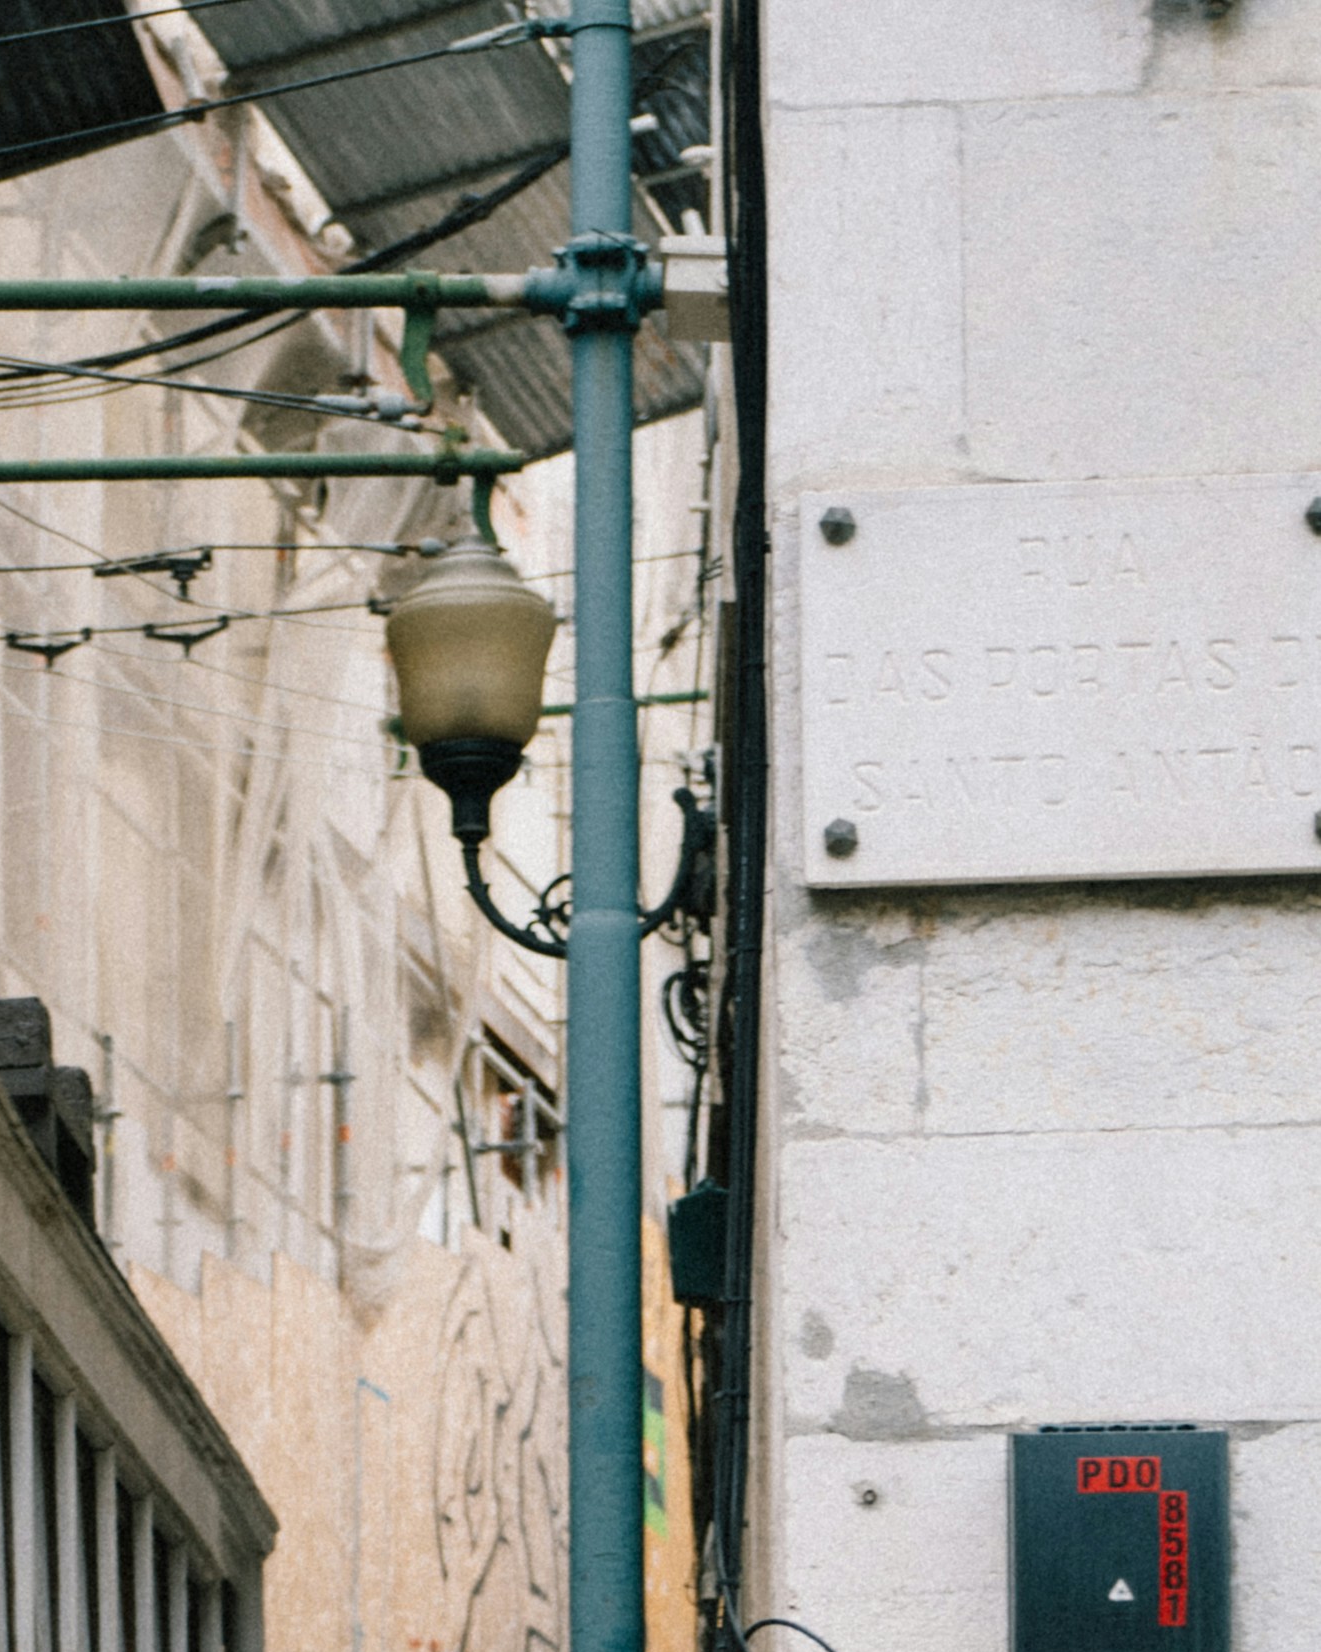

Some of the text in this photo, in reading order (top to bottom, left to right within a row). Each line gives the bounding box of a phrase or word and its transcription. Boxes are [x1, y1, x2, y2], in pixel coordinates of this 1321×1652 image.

[1018, 531, 1147, 589] RUA
[823, 635, 1321, 707] DAS PORTAS D
[852, 753, 1070, 814] SANTO
[1081, 1459, 1157, 1489] PDO
[1164, 1495, 1185, 1622] 8581
